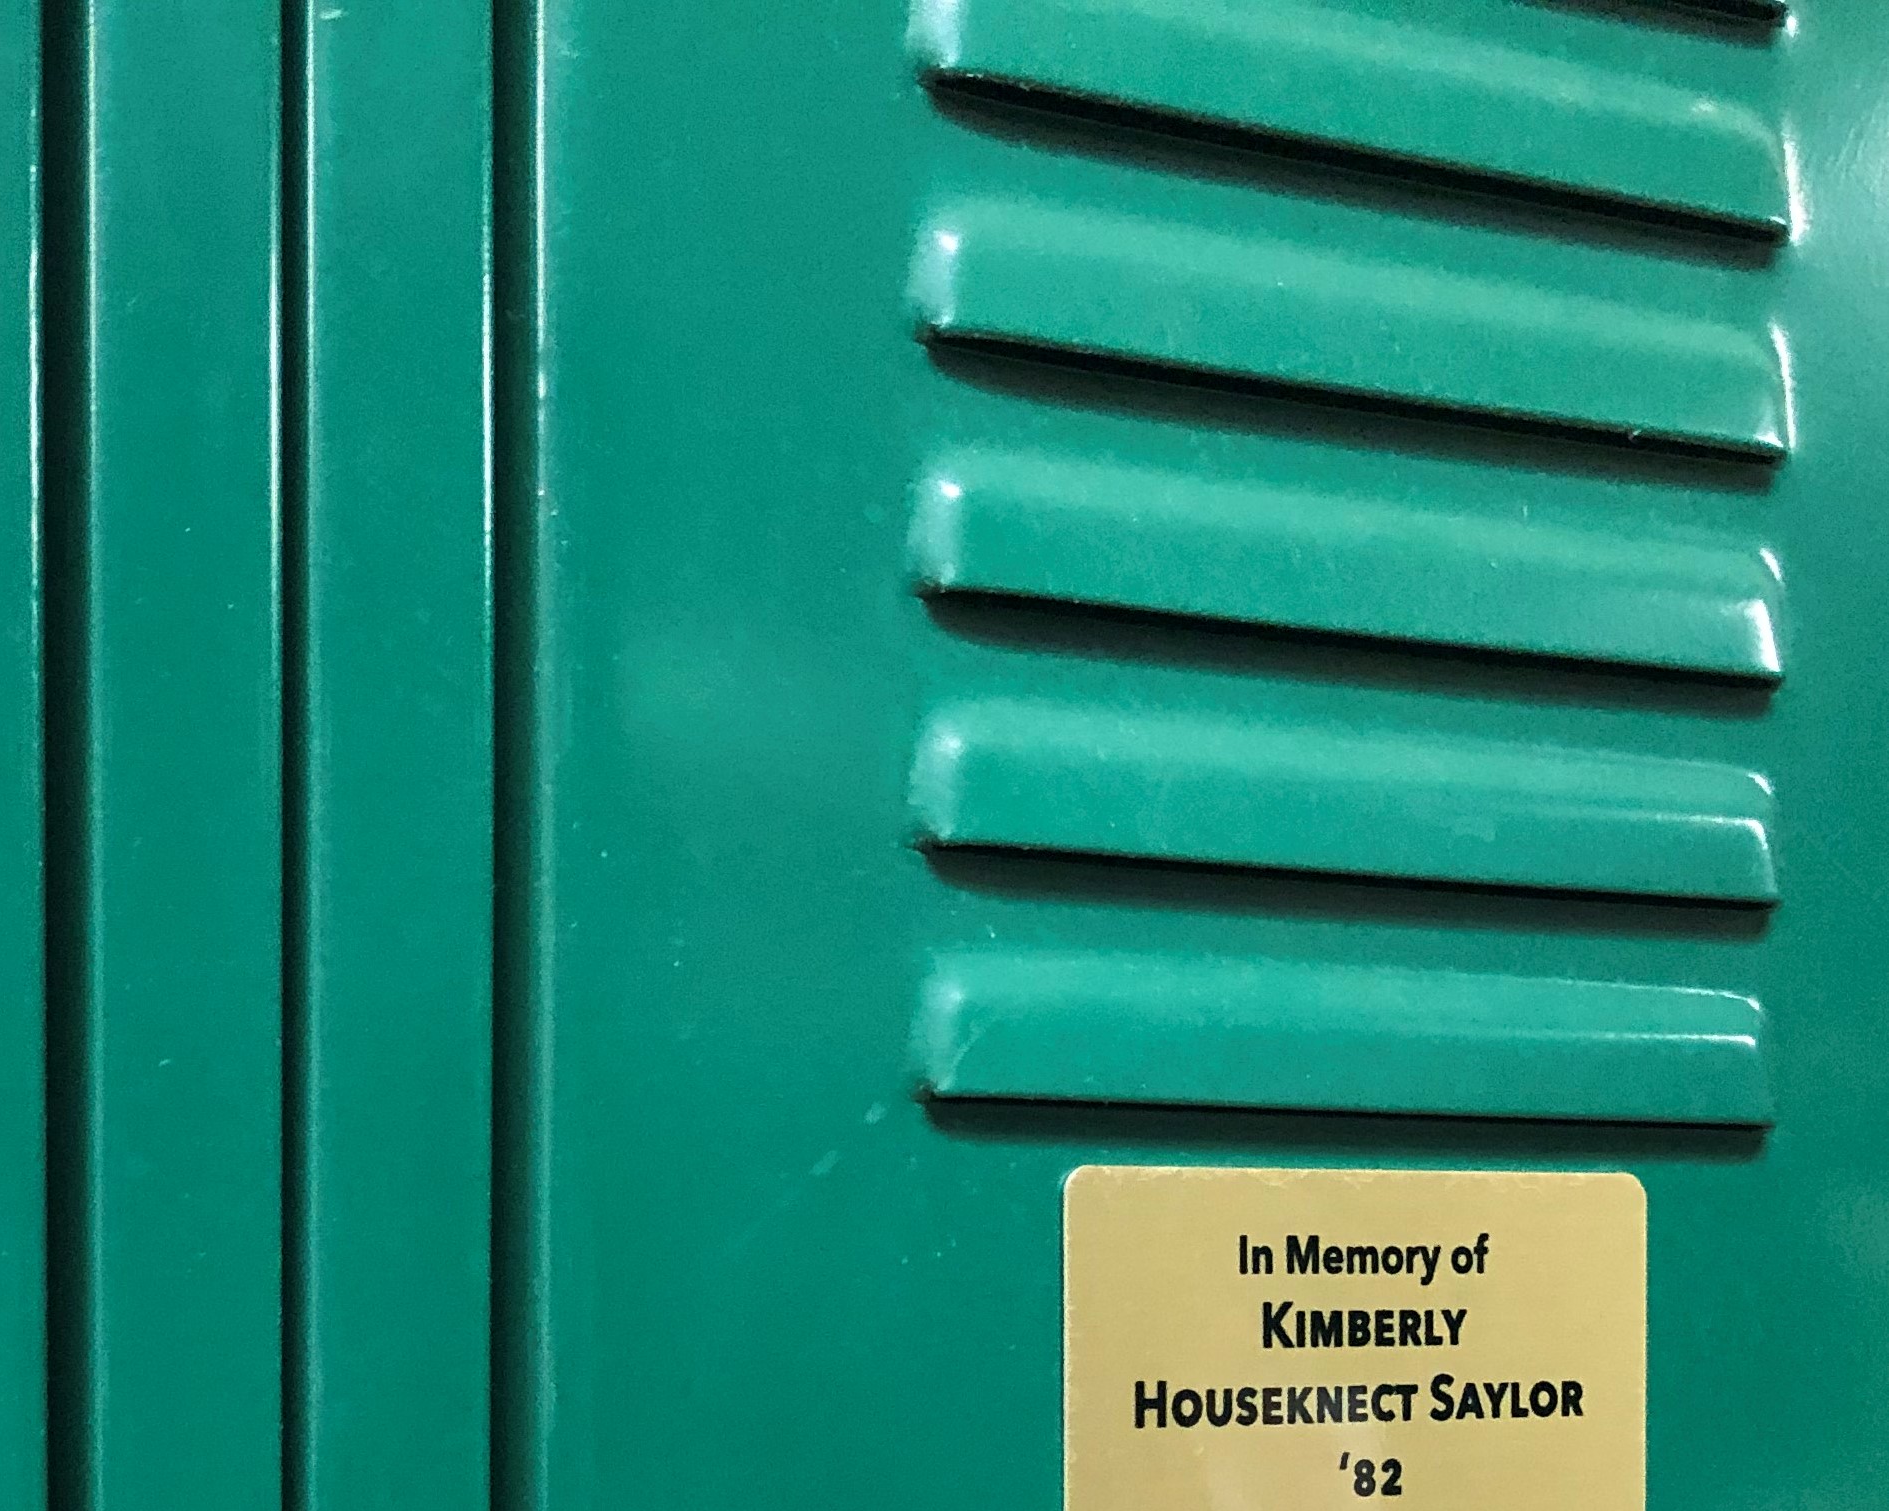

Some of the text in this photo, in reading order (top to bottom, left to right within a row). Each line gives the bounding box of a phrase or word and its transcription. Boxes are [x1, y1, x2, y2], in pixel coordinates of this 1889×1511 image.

[1239, 1232, 1490, 1286] In Memory of
[1262, 1301, 1468, 1349] KIMBERLY
[1134, 1373, 1584, 1429] HOUSEKNECT SAYLOR
